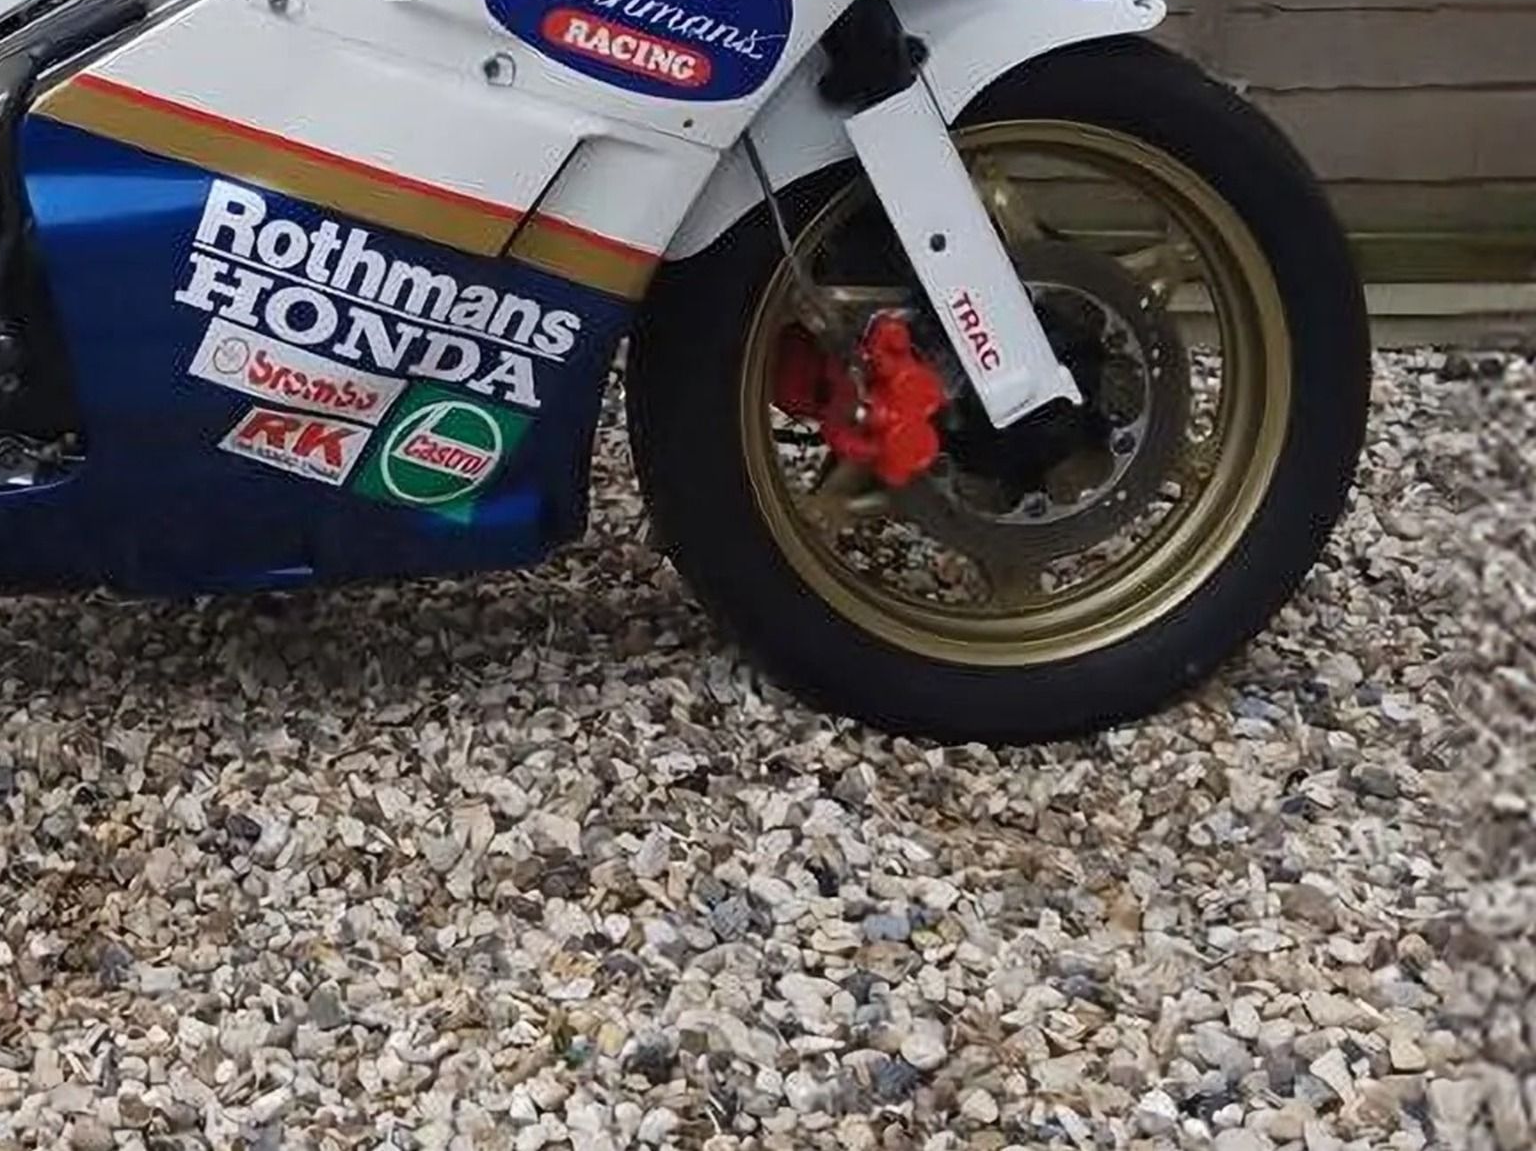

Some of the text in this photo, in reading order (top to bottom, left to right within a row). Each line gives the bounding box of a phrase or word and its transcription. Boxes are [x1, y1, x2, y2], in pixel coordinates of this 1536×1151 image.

[563, 17, 697, 80] RACING
[195, 178, 582, 355] Rothmans
[174, 252, 542, 409] HONDA
[951, 291, 1000, 372] TRAC
[237, 411, 358, 469] RK
